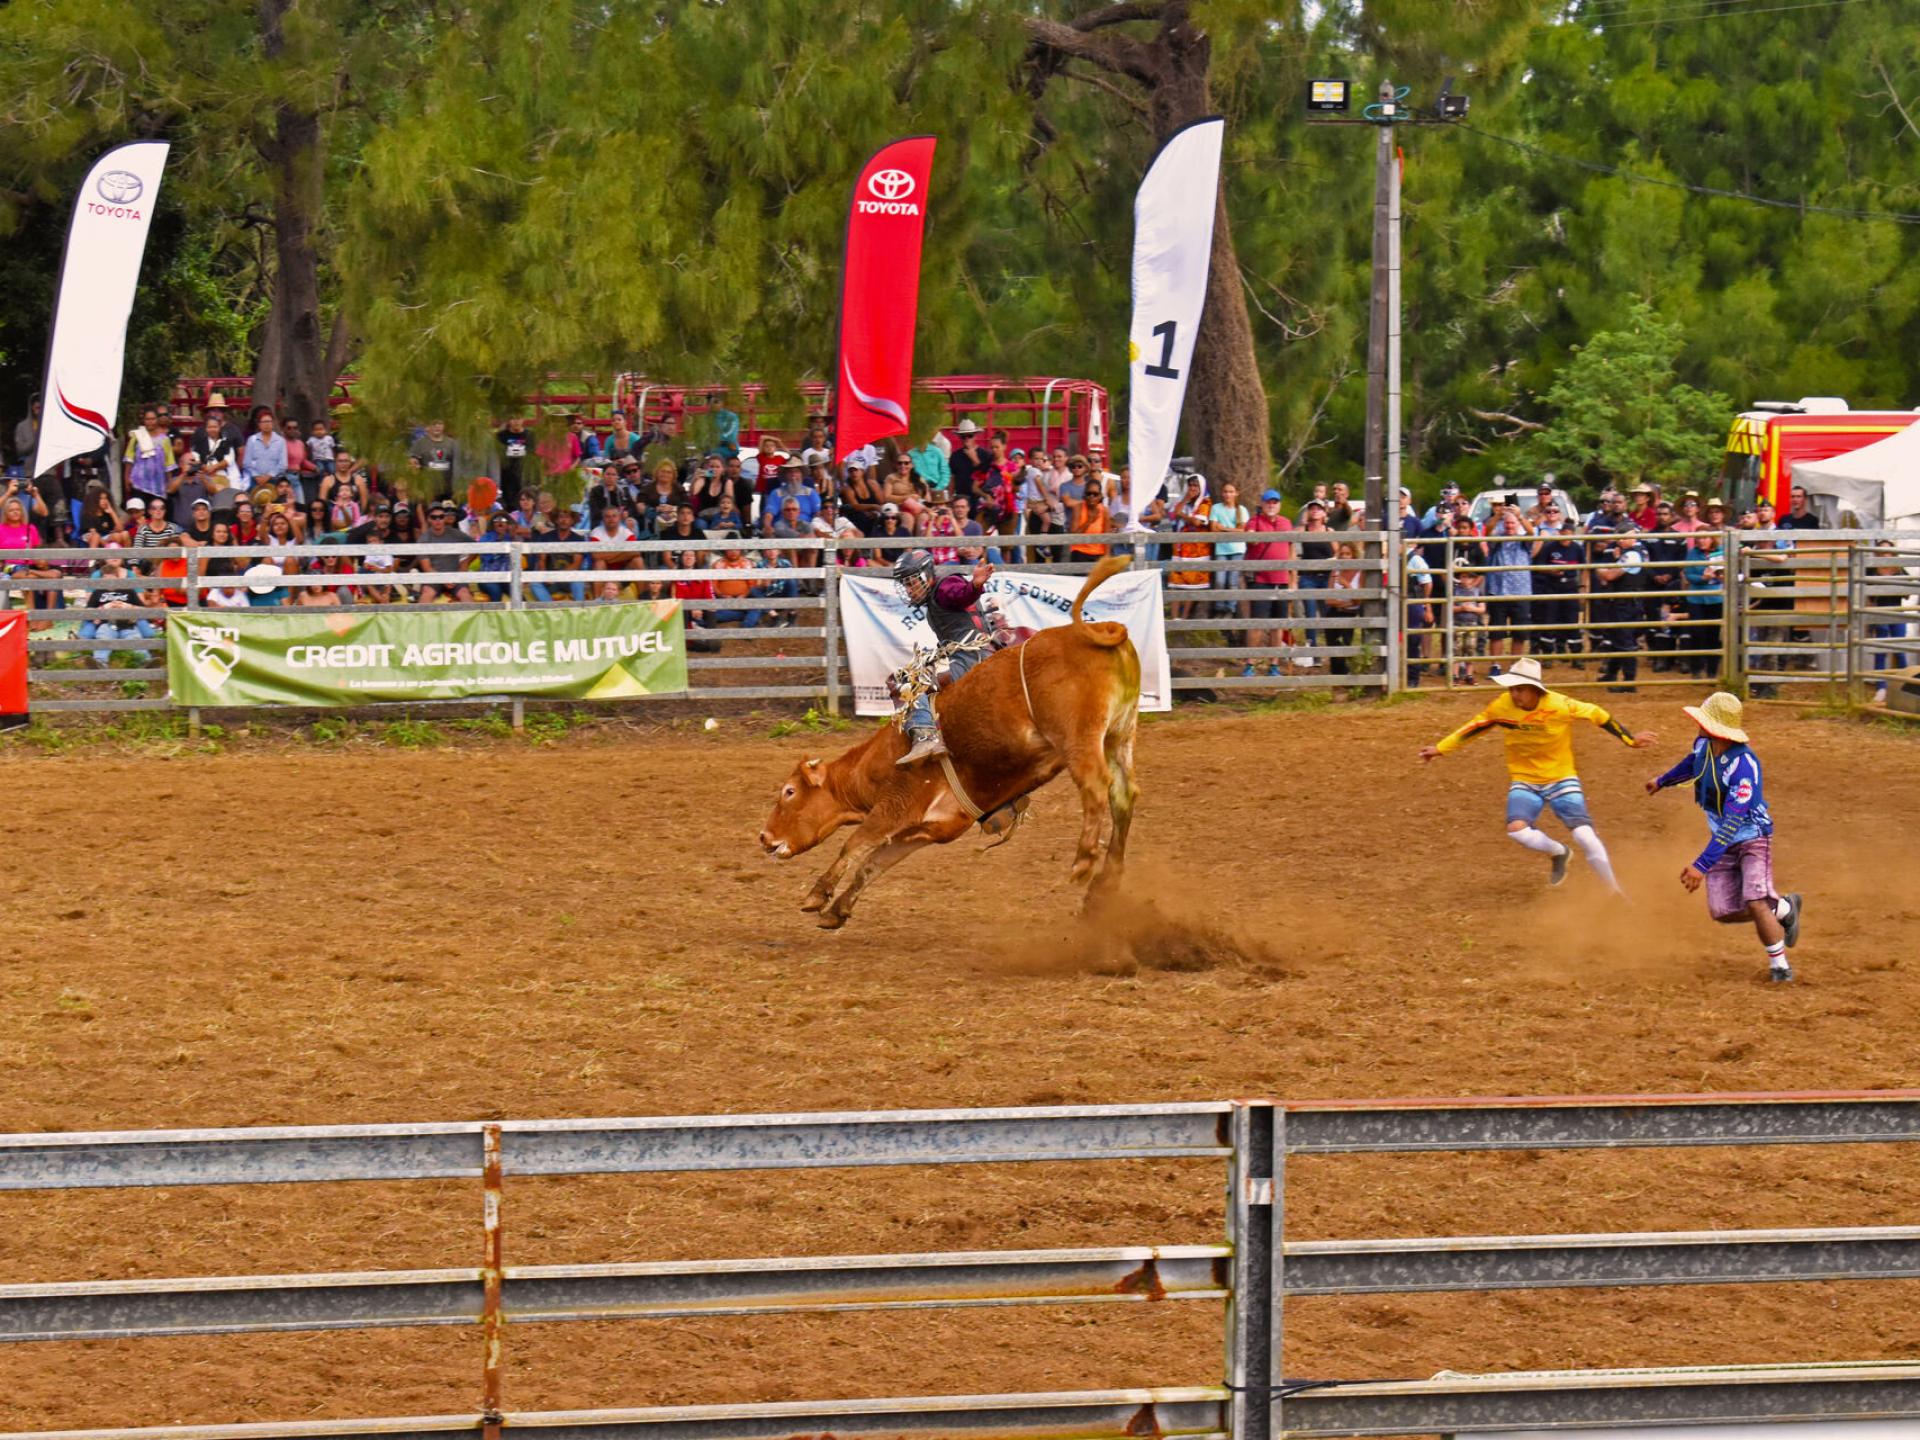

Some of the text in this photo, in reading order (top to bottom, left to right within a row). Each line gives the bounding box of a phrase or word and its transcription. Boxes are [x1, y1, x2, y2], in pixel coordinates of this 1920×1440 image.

[88, 202, 141, 220] TOYOTA
[857, 201, 919, 216] TOYOTA
[1144, 320, 1180, 380] 1
[286, 631, 673, 668] CREDIT AGRICOLE MUTUEL
